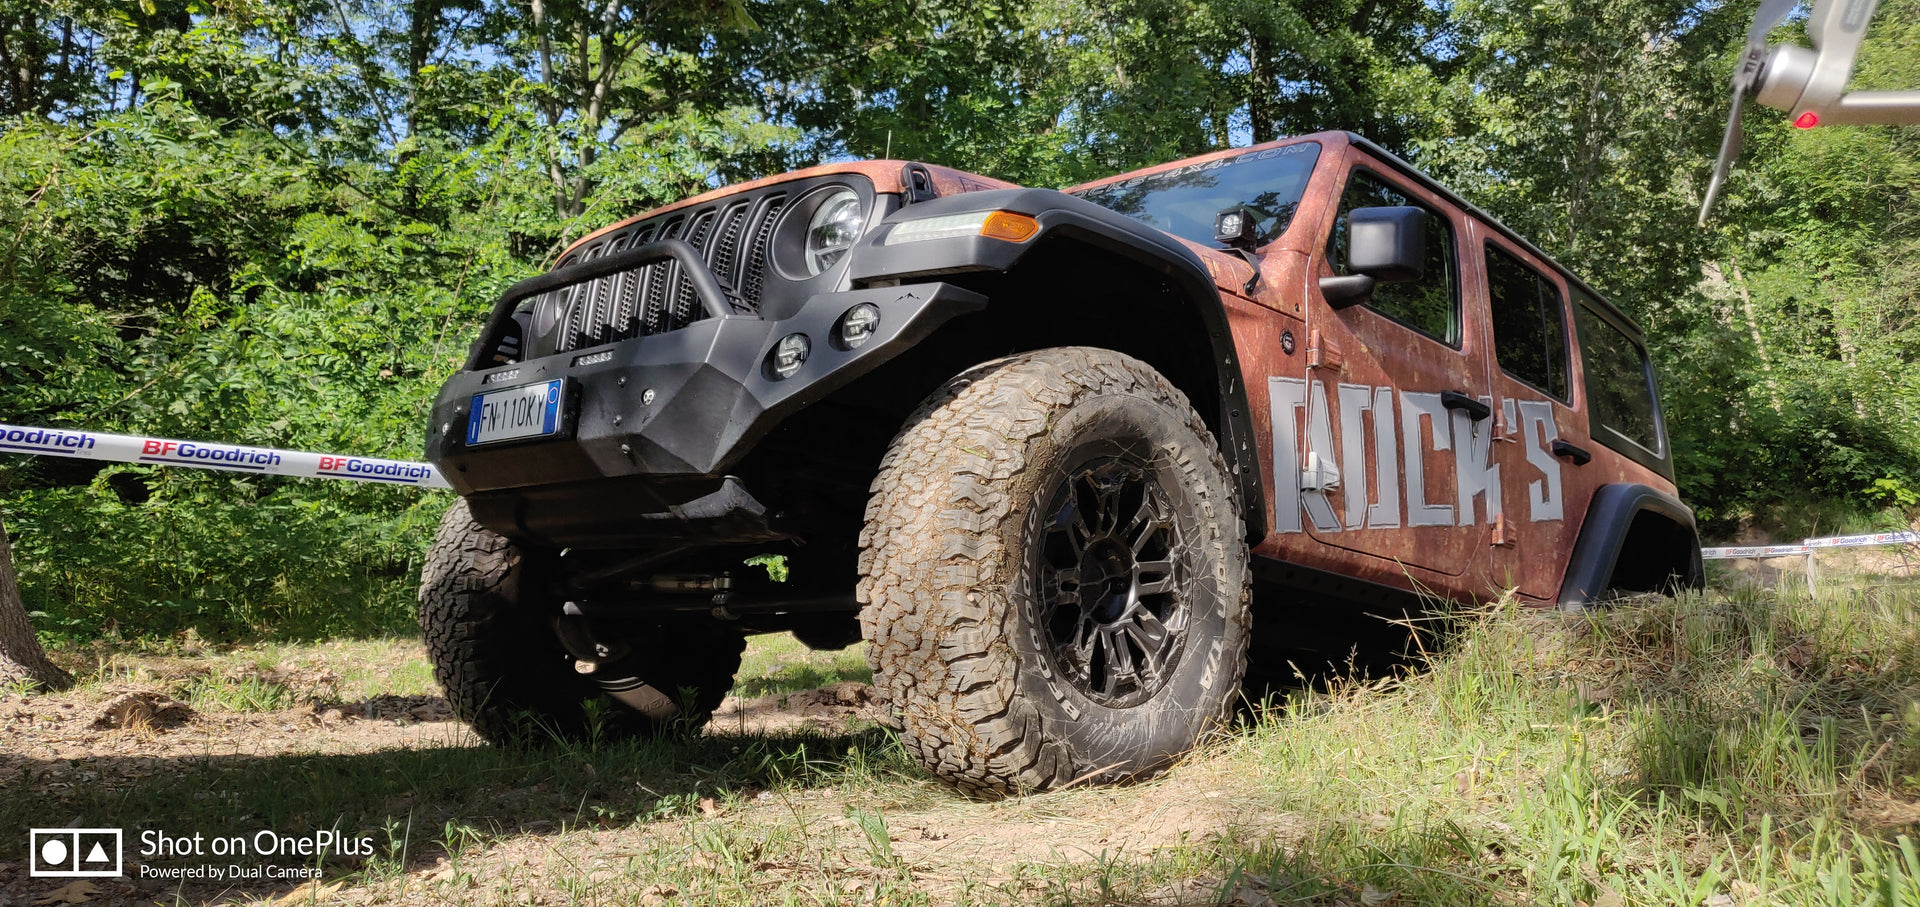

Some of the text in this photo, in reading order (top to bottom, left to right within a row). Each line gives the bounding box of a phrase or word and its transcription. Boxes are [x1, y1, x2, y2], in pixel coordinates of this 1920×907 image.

[142, 440, 281, 466] BFGoodrich
[318, 456, 431, 478] BFGoodrich
[1832, 536, 1868, 545] BFGoodrich
